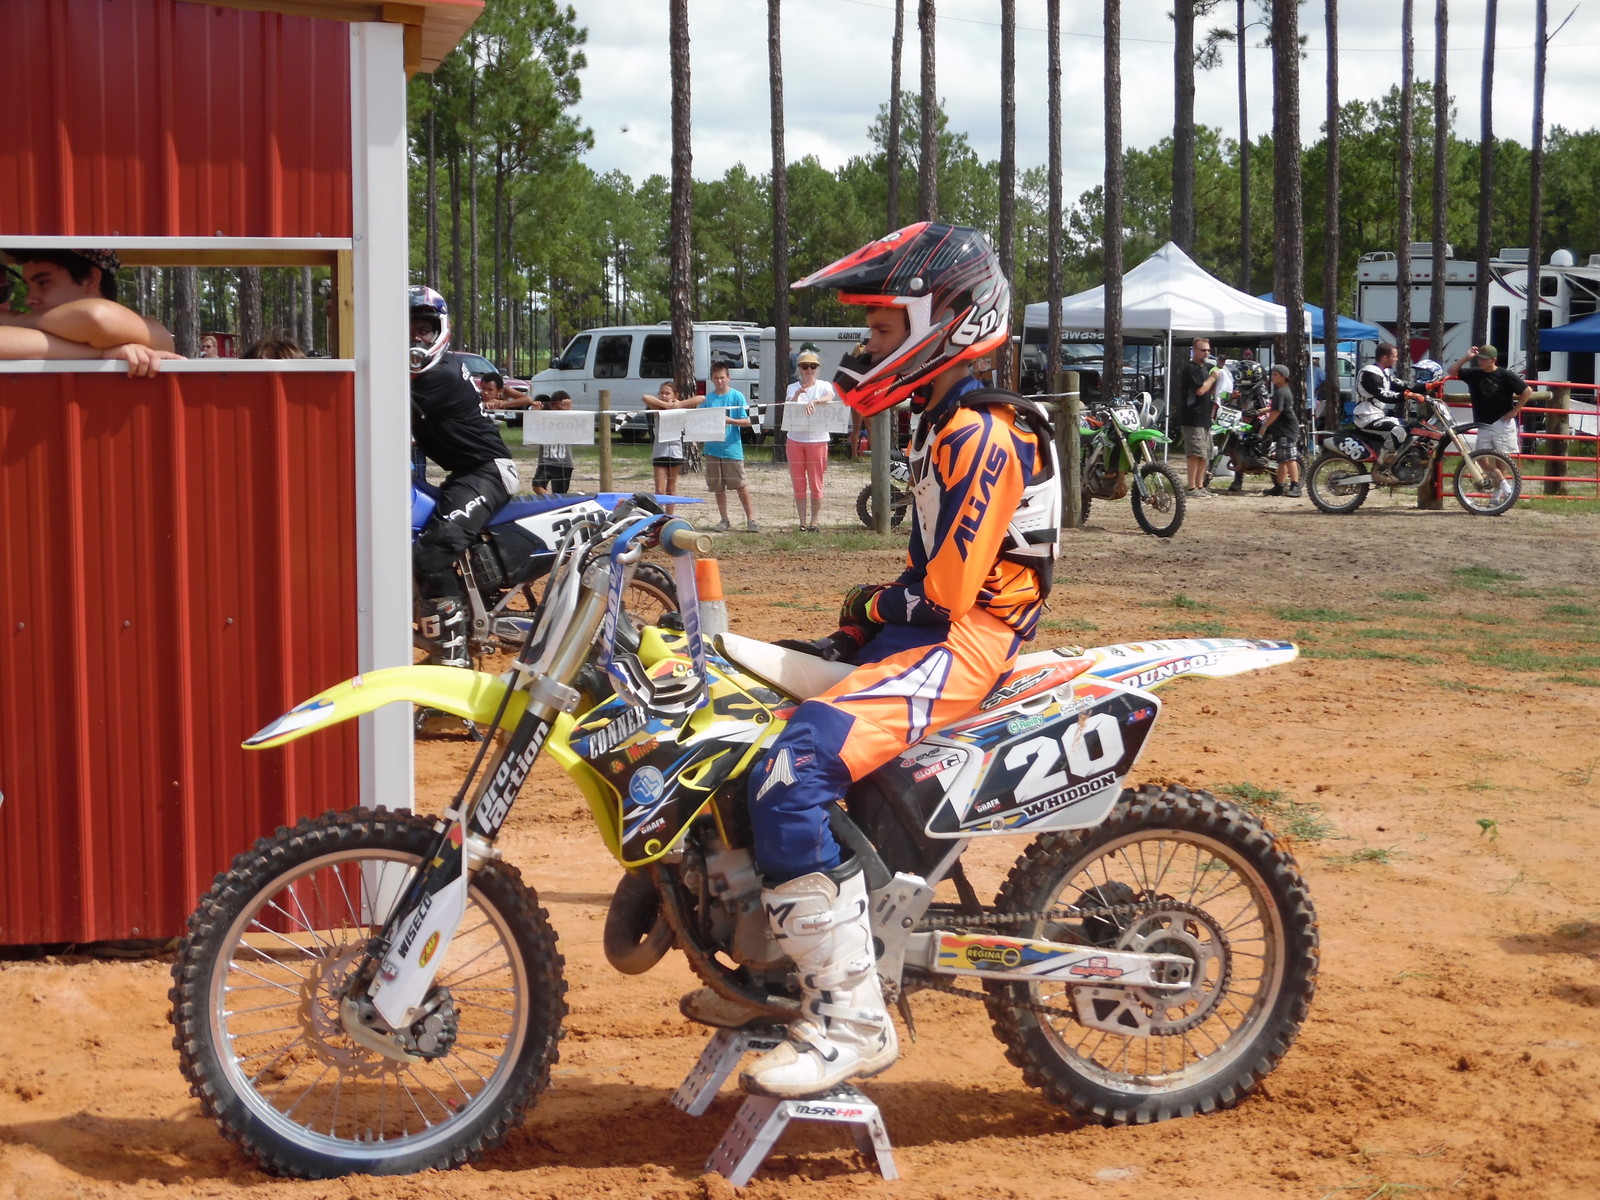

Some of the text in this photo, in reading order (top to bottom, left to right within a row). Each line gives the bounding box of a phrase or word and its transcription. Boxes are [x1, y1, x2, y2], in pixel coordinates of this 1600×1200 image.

[837, 332, 861, 340] GLADIATOR
[951, 304, 997, 345] 6D
[1062, 329, 1104, 339] awasa
[1121, 652, 1222, 688] DUNLOP
[589, 705, 647, 759] CONNER
[1009, 714, 1044, 734] O'Reilly
[487, 721, 549, 829] action
[914, 763, 942, 780] GLOBE
[1003, 712, 1125, 804] 20
[1022, 772, 1117, 818] WHIDDON
[398, 891, 433, 959] WISECO
[967, 949, 1001, 960] REGINA
